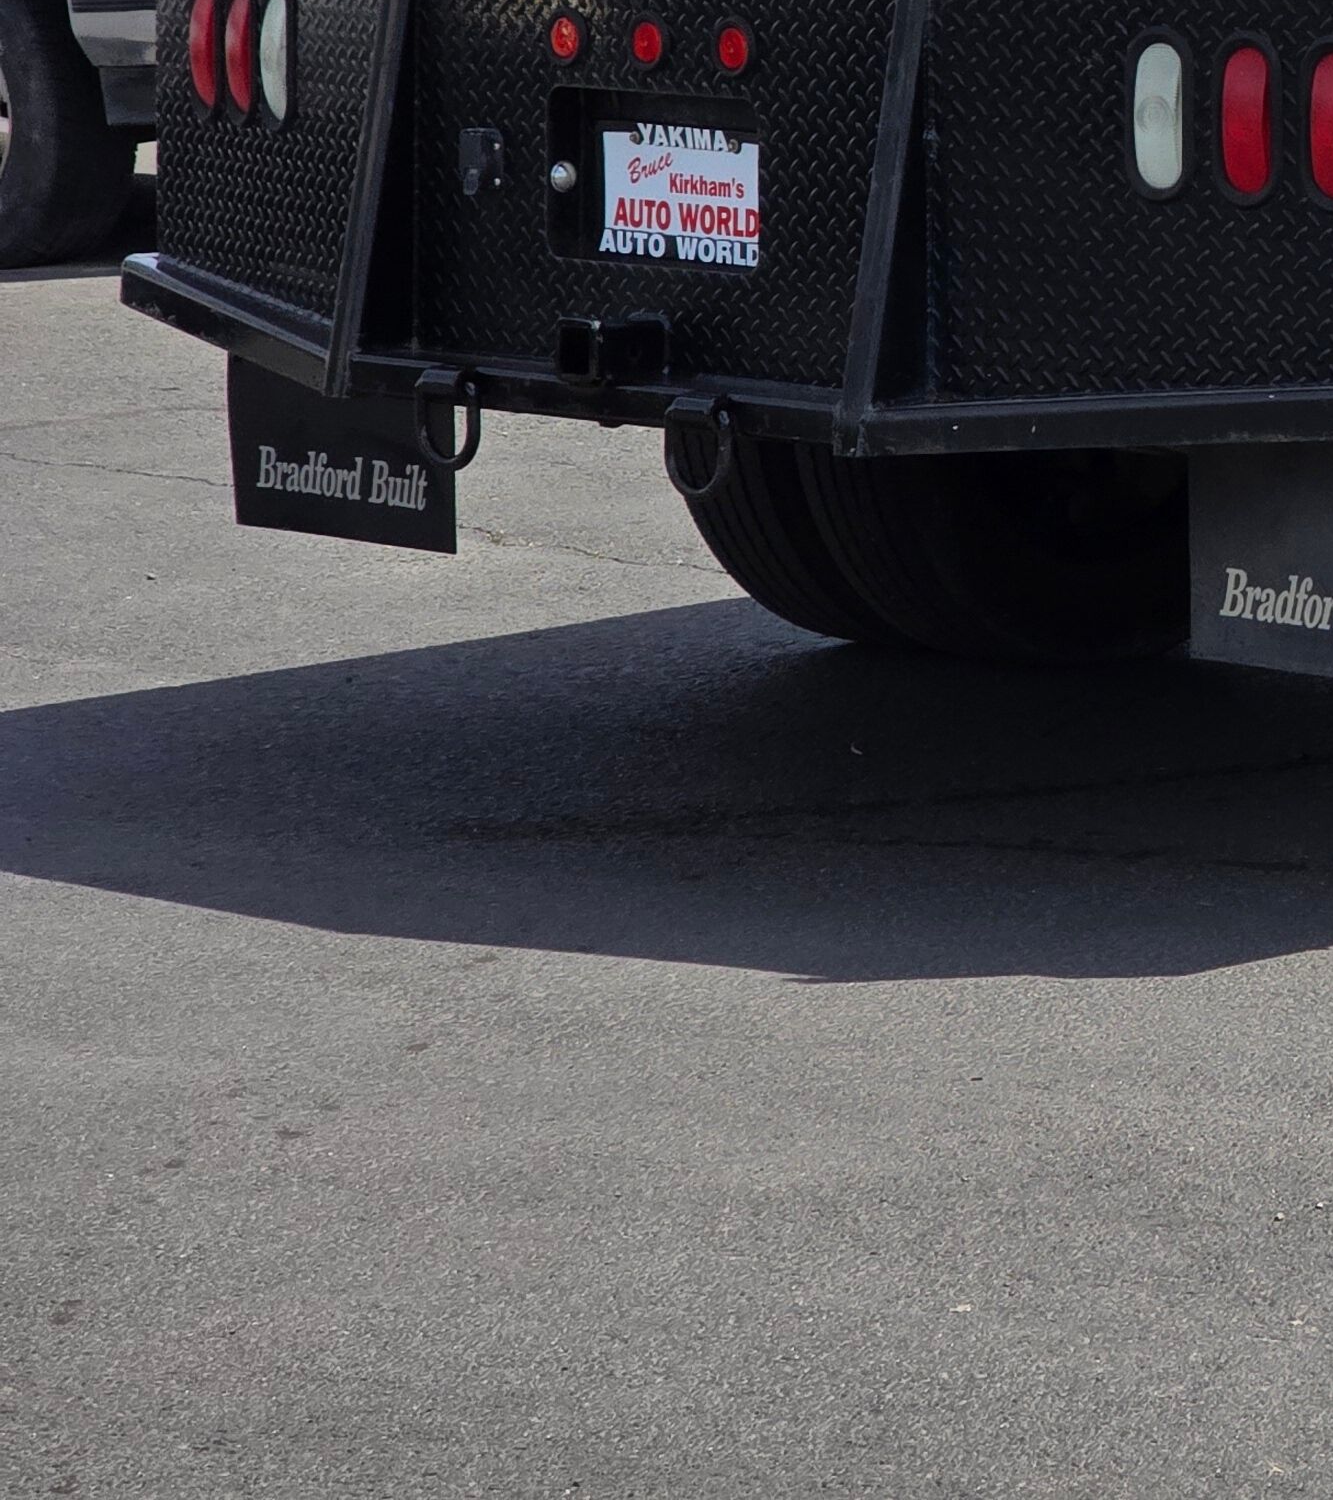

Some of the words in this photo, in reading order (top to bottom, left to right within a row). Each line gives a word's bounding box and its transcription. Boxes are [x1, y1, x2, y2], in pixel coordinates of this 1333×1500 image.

[636, 122, 730, 152] YAKIMA
[627, 152, 674, 184] Bruce
[669, 173, 745, 199] Kirkham's
[613, 197, 672, 231] AUTO
[678, 202, 761, 238] WORLD
[599, 229, 667, 258] AUTO
[675, 236, 759, 267] WORLD
[256, 445, 364, 501] Bradford
[368, 460, 428, 511] Built
